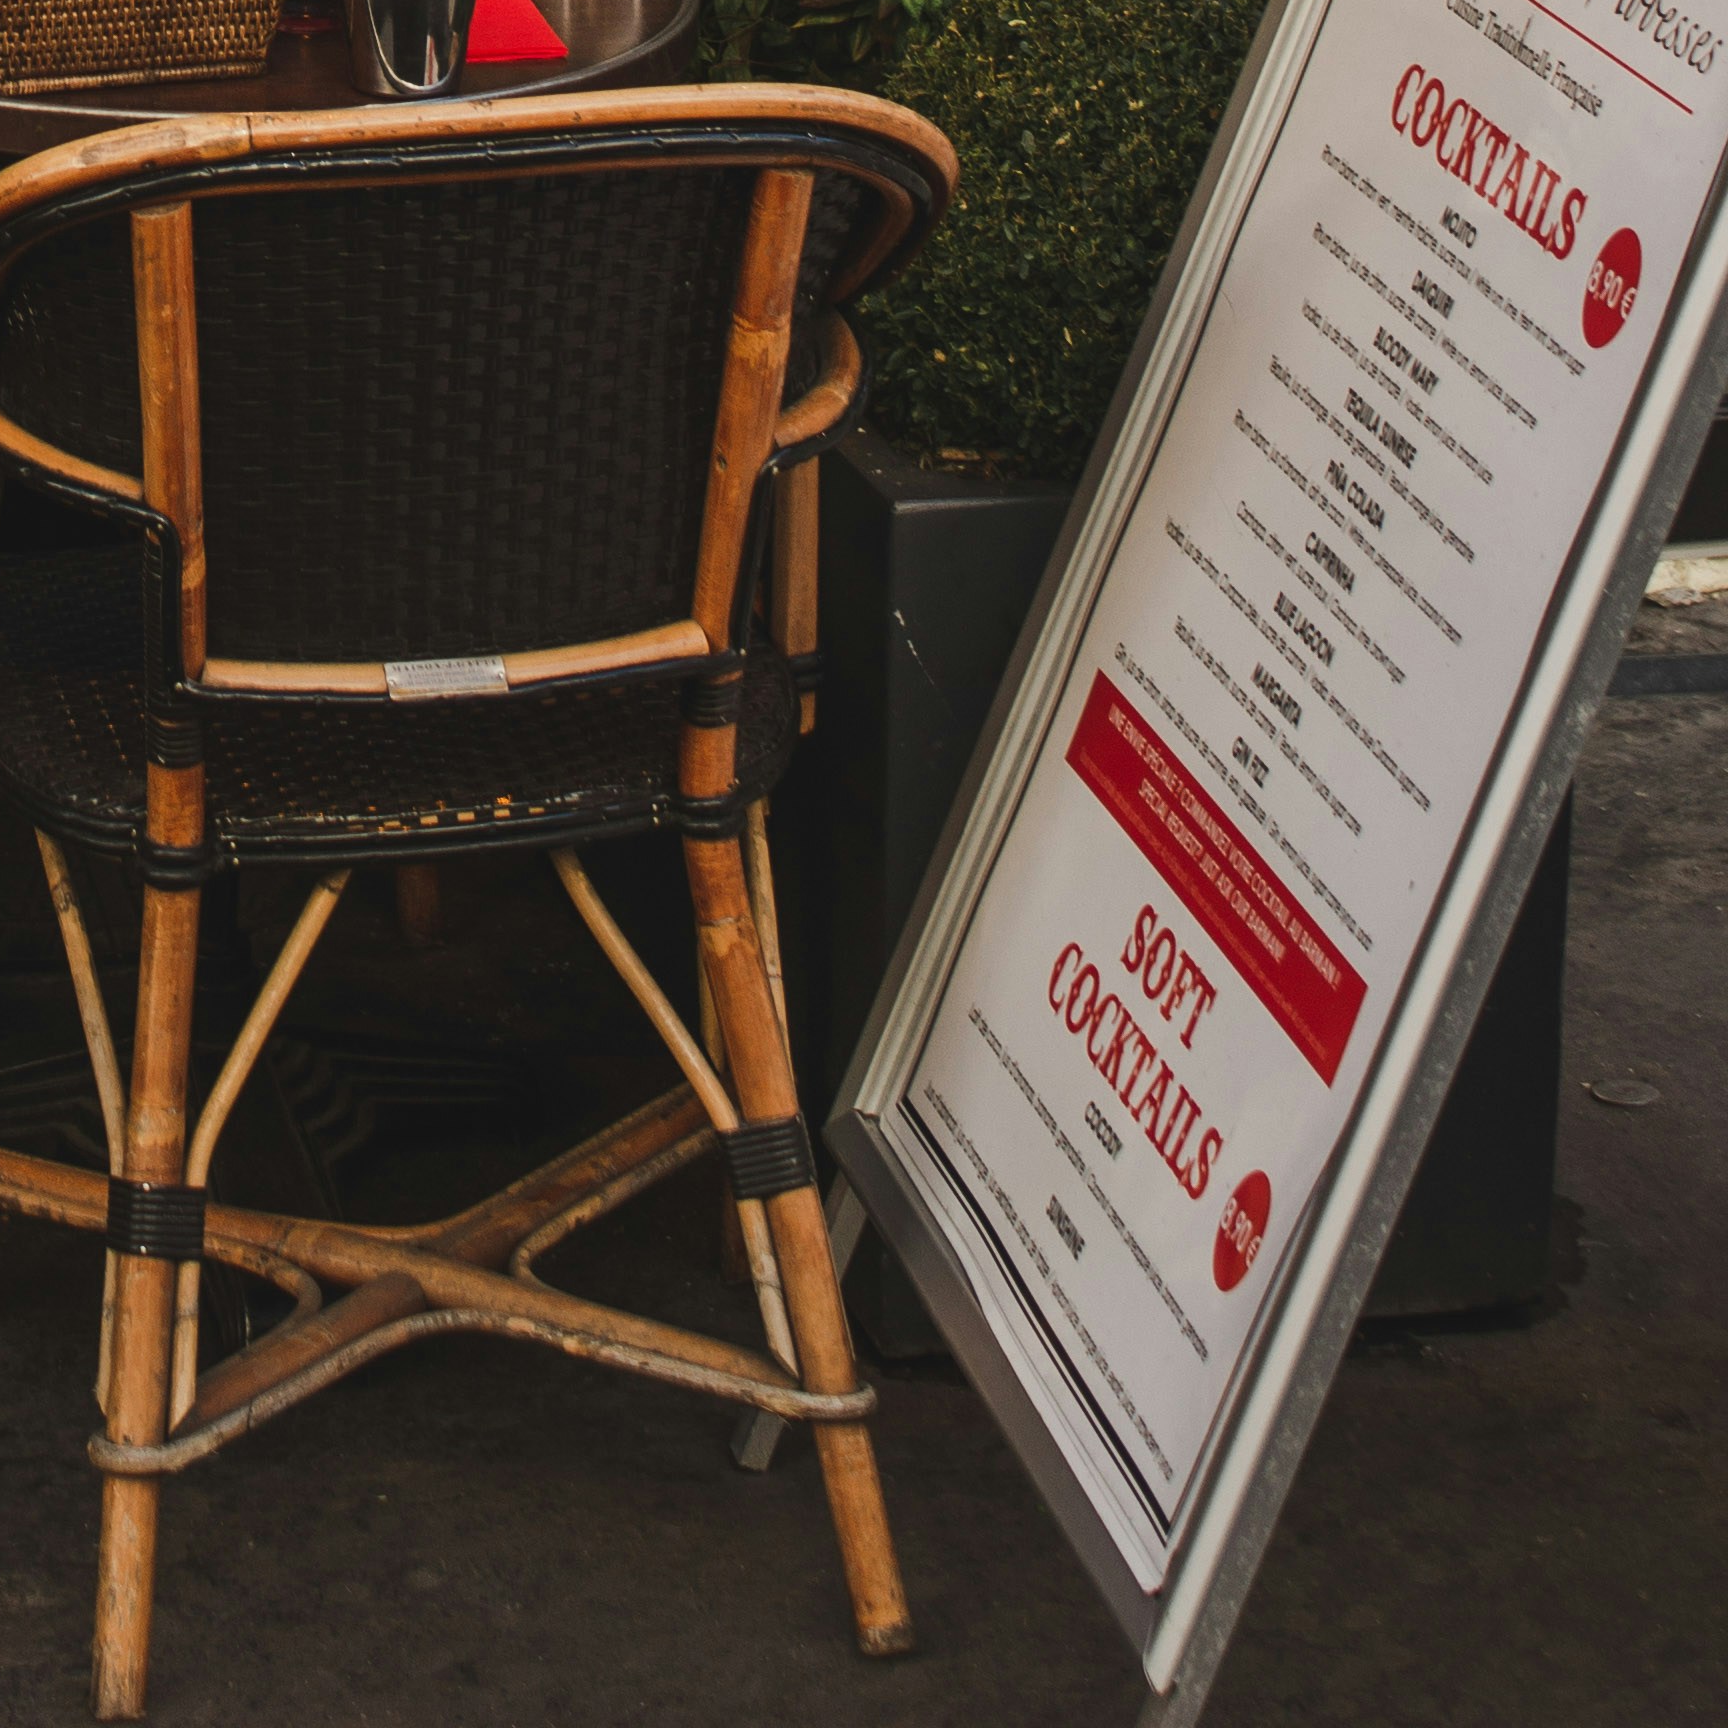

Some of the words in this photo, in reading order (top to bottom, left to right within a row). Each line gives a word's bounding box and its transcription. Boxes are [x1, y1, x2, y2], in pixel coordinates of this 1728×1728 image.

[1550, 60, 1603, 118] Française
[1391, 63, 1588, 261] COCKTAILS
[1441, 207, 1477, 249] MOJITO
[1373, 326, 1412, 368] BLOODY
[1410, 361, 1439, 392] MARY
[1346, 387, 1381, 434] TEQUILA
[1378, 421, 1417, 469] SUNRISE
[1327, 459, 1348, 495] PIÑA
[1347, 481, 1385, 530] COLADA
[1273, 591, 1298, 627] BLUE
[1293, 618, 1335, 667] LAGOON
[1252, 664, 1302, 727] MARGARITA
[1232, 736, 1252, 768] GIN
[1251, 754, 1270, 789] FIZZ
[1120, 904, 1218, 1050] SOFT
[1048, 942, 1224, 1201] COCKTAILS
[1084, 1101, 1123, 1156] COCODY
[1046, 1195, 1085, 1261] SUNSHINE
